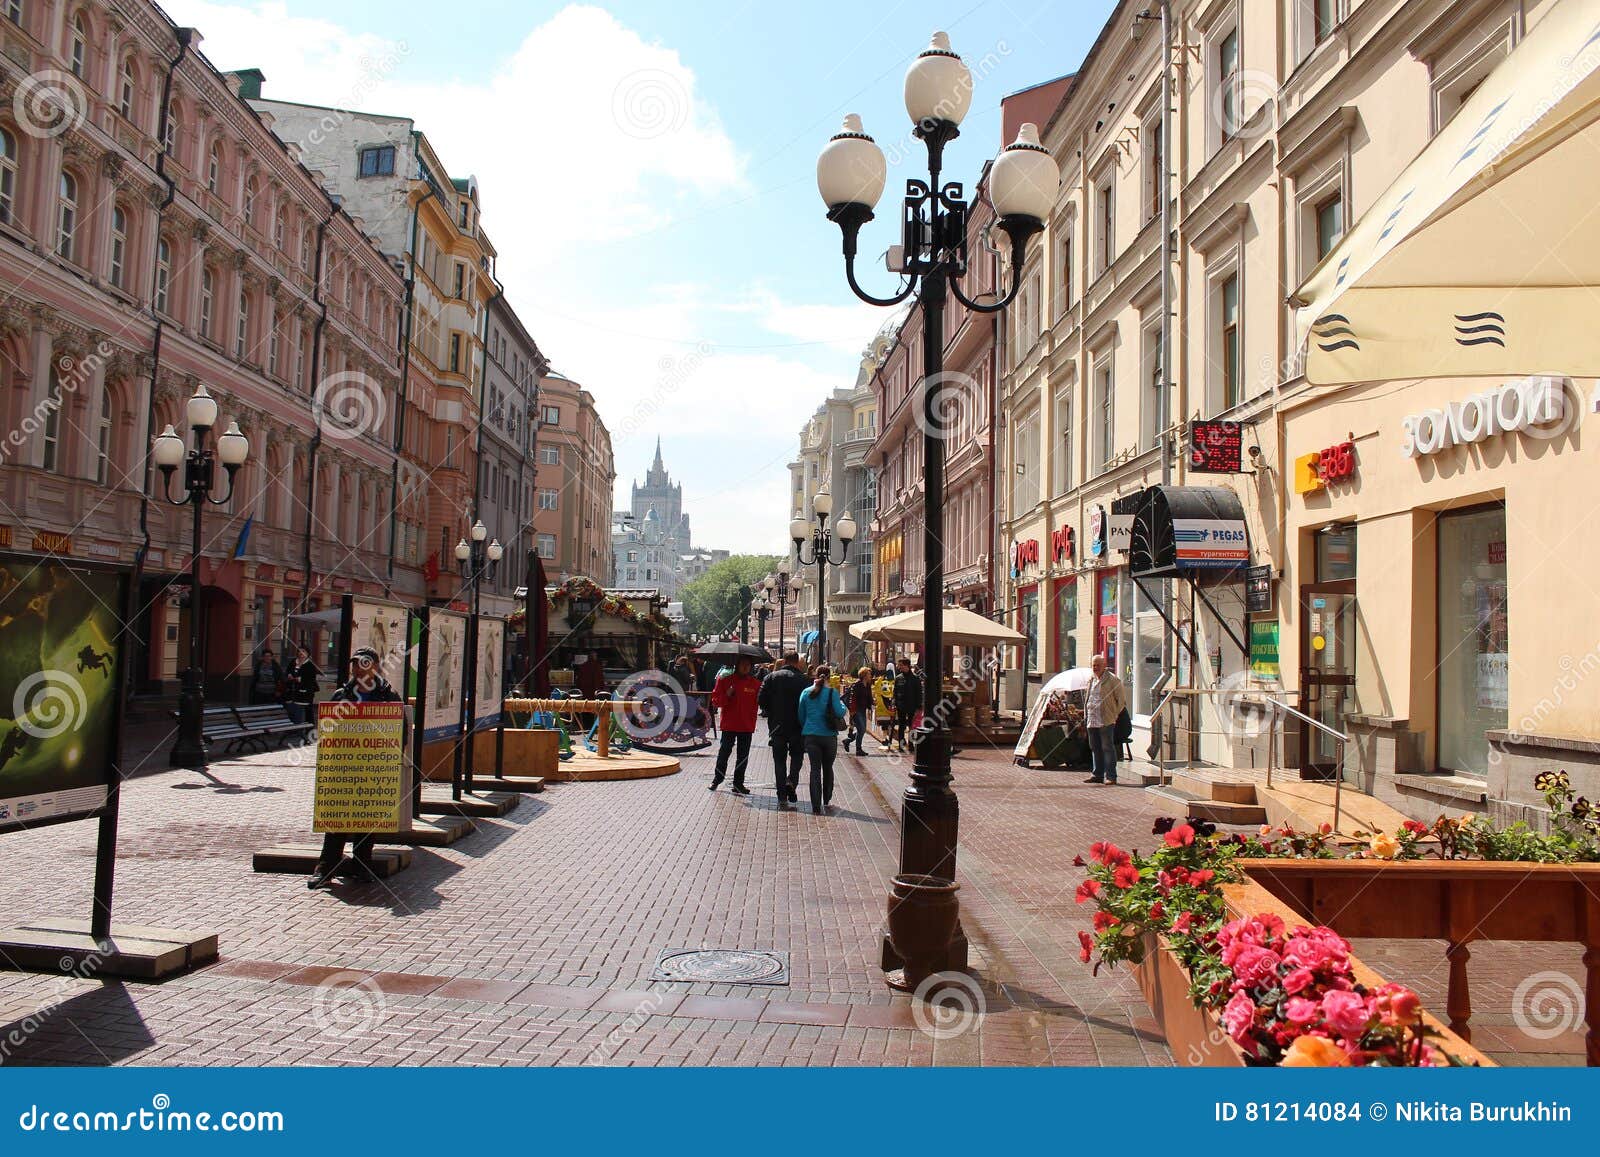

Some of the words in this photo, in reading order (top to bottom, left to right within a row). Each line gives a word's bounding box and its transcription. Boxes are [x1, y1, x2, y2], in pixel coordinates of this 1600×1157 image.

[1213, 530, 1244, 540] PEGAS
[319, 738, 360, 748] ПОКУПКА
[363, 738, 400, 750] ОЦЕНКА
[318, 752, 354, 760] золото
[357, 751, 399, 762] серебро
[366, 764, 399, 773] изделия
[317, 775, 368, 785] самовары
[370, 776, 398, 786] чугун
[318, 786, 353, 795] бронза
[356, 786, 397, 796] фарфор
[317, 799, 349, 807] иконы
[352, 799, 396, 808] картины
